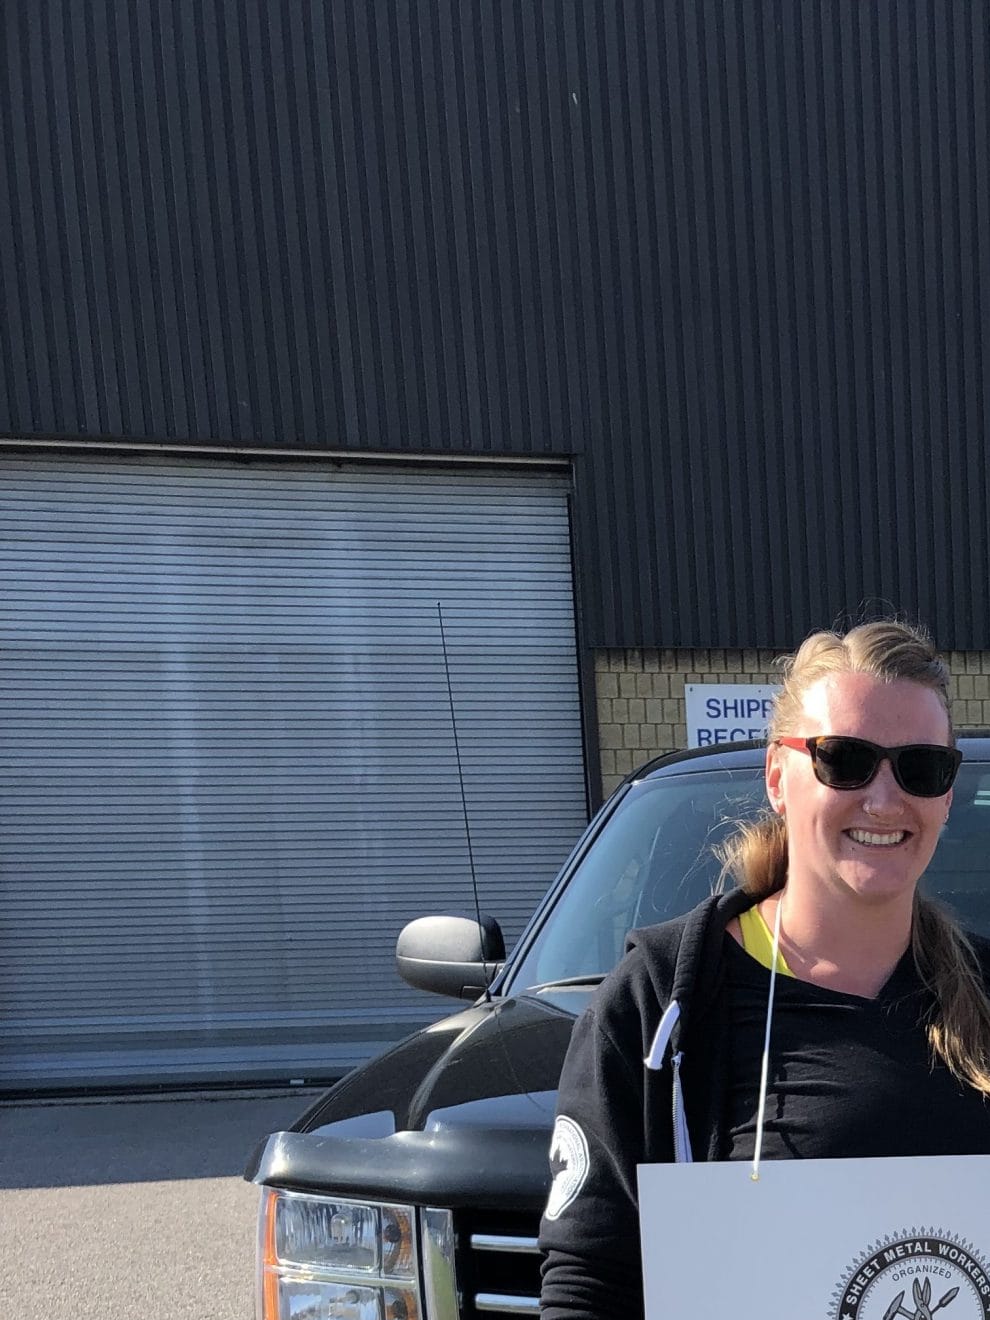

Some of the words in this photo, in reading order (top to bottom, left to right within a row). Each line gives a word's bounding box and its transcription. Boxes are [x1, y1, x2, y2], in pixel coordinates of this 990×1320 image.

[846, 1259, 881, 1305] SHEET
[883, 1241, 932, 1264] METAL
[892, 1264, 952, 1281] ORGANIZED
